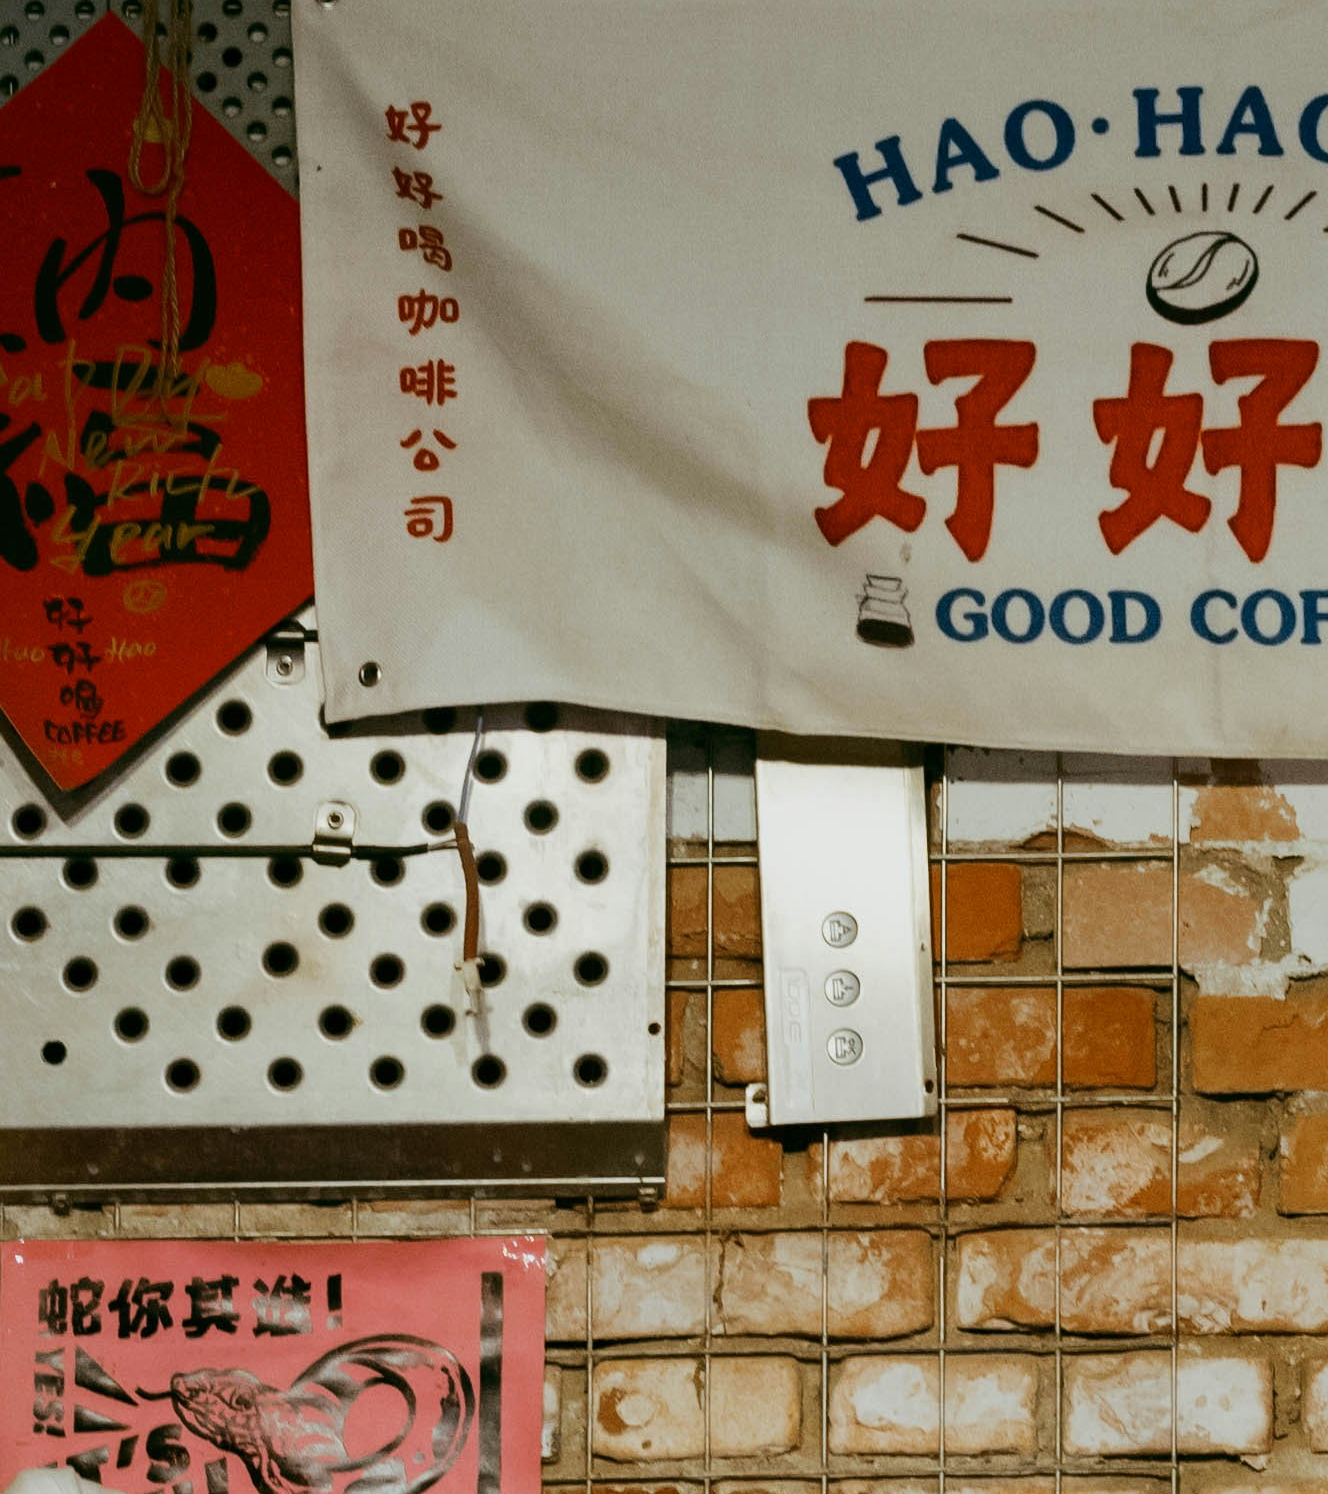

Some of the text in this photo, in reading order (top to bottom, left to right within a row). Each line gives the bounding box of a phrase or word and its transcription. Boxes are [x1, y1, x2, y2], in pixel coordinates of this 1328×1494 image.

[385, 99, 461, 544] 好好喝咖啡公司
[936, 589, 1161, 647] GOOD
[43, 719, 128, 745] COFFEE
[33, 1348, 65, 1437] YES!
